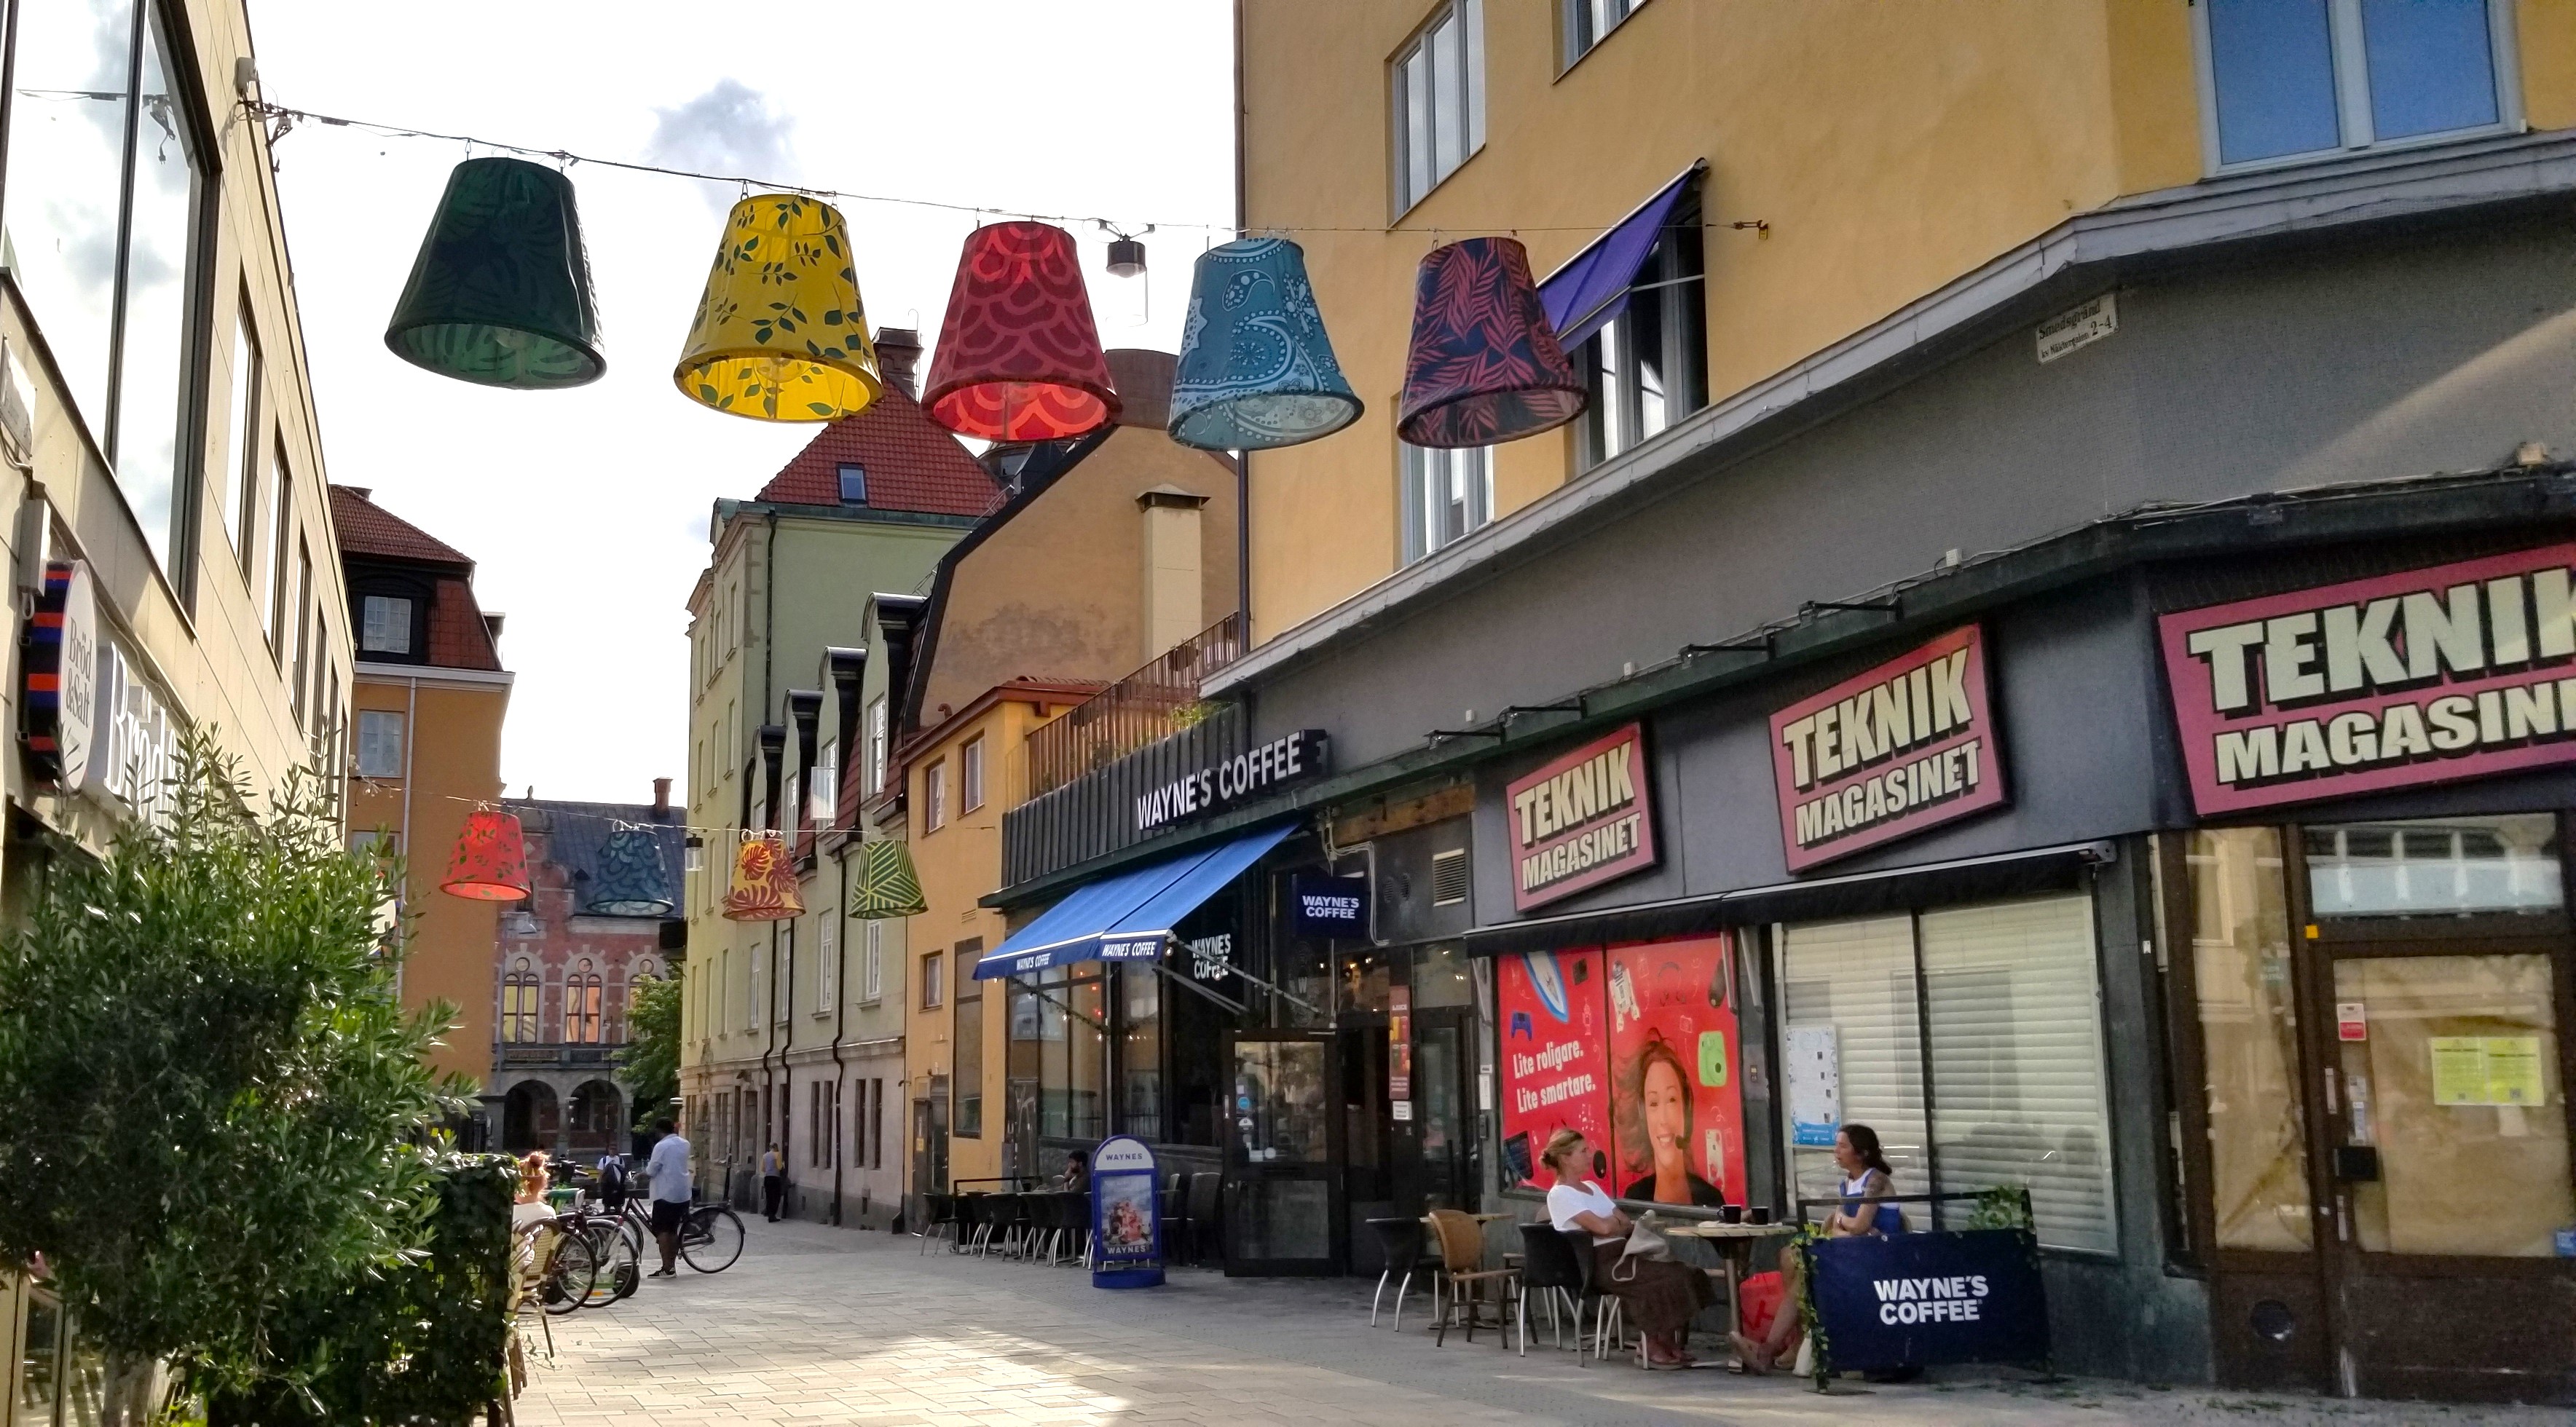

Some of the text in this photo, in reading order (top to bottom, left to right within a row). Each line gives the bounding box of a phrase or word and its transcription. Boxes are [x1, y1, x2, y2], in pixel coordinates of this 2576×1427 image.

[2039, 299, 2100, 340] Smedsgränd
[2090, 315, 2113, 336] 2-4
[68, 617, 92, 683] Bröd
[1781, 646, 1973, 790] TEKNIK
[1137, 731, 1302, 830] WAYNE'S COFFEE
[1513, 739, 1636, 847] TEKNIK
[1793, 737, 1982, 847] MAGASINET
[1521, 810, 1642, 892] MAGASINET
[1301, 895, 1360, 909] WAYNE'S
[1306, 906, 1356, 919] COFFEE
[1131, 941, 1157, 957] COFFEE
[1513, 1040, 1584, 1079] Lite roligare.
[1516, 1073, 1596, 1114] Lite smartare.
[1106, 1153, 1143, 1161] WAYNES
[1107, 1245, 1146, 1254] WAYNES
[1873, 1275, 1990, 1302] WAYNE'S
[1879, 1299, 1981, 1326] COFFEE
